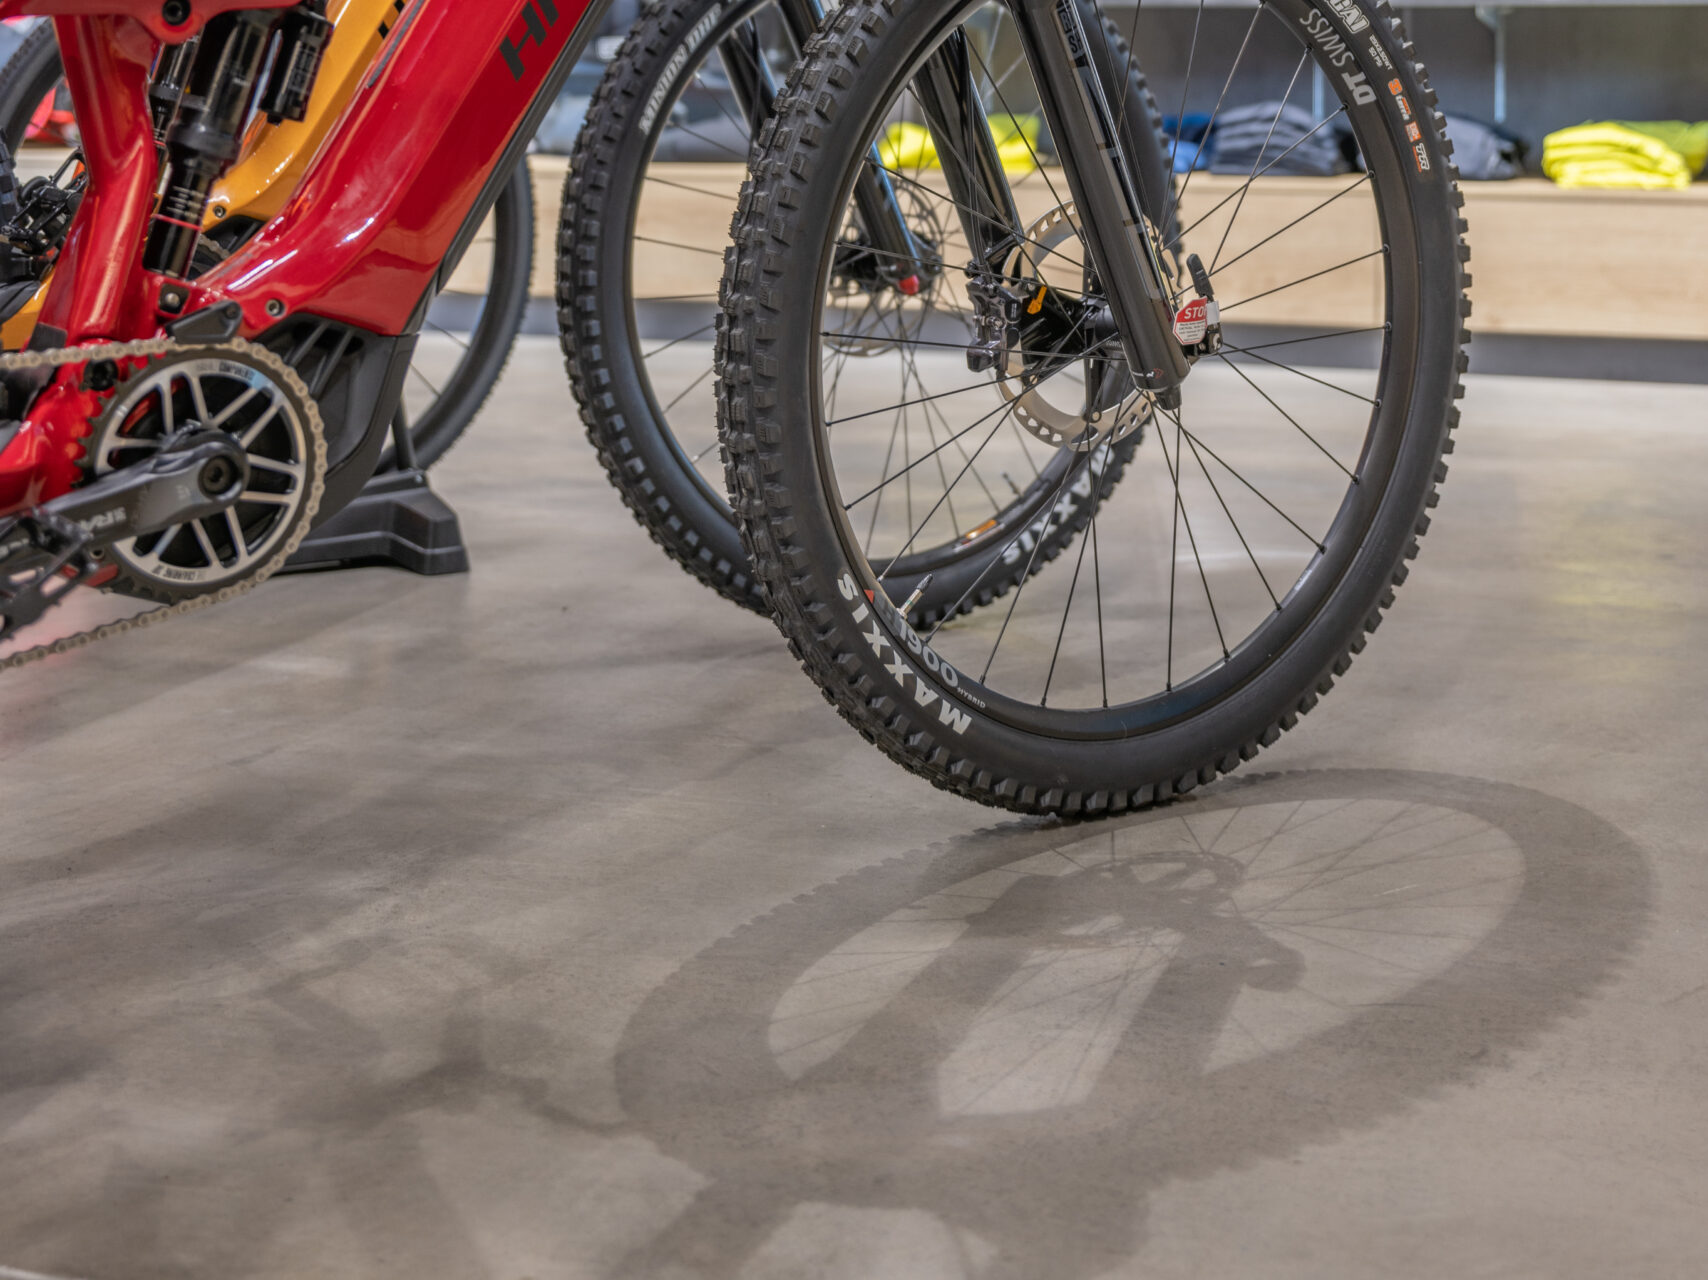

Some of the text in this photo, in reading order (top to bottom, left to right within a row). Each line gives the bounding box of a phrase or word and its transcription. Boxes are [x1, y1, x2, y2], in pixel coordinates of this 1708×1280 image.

[1300, 8, 1377, 106] DT SWISS
[1001, 442, 1115, 566] MAXXIS
[837, 572, 972, 736] MAXXIS
[899, 618, 959, 687] 1900
[956, 685, 986, 709] HYBRID
